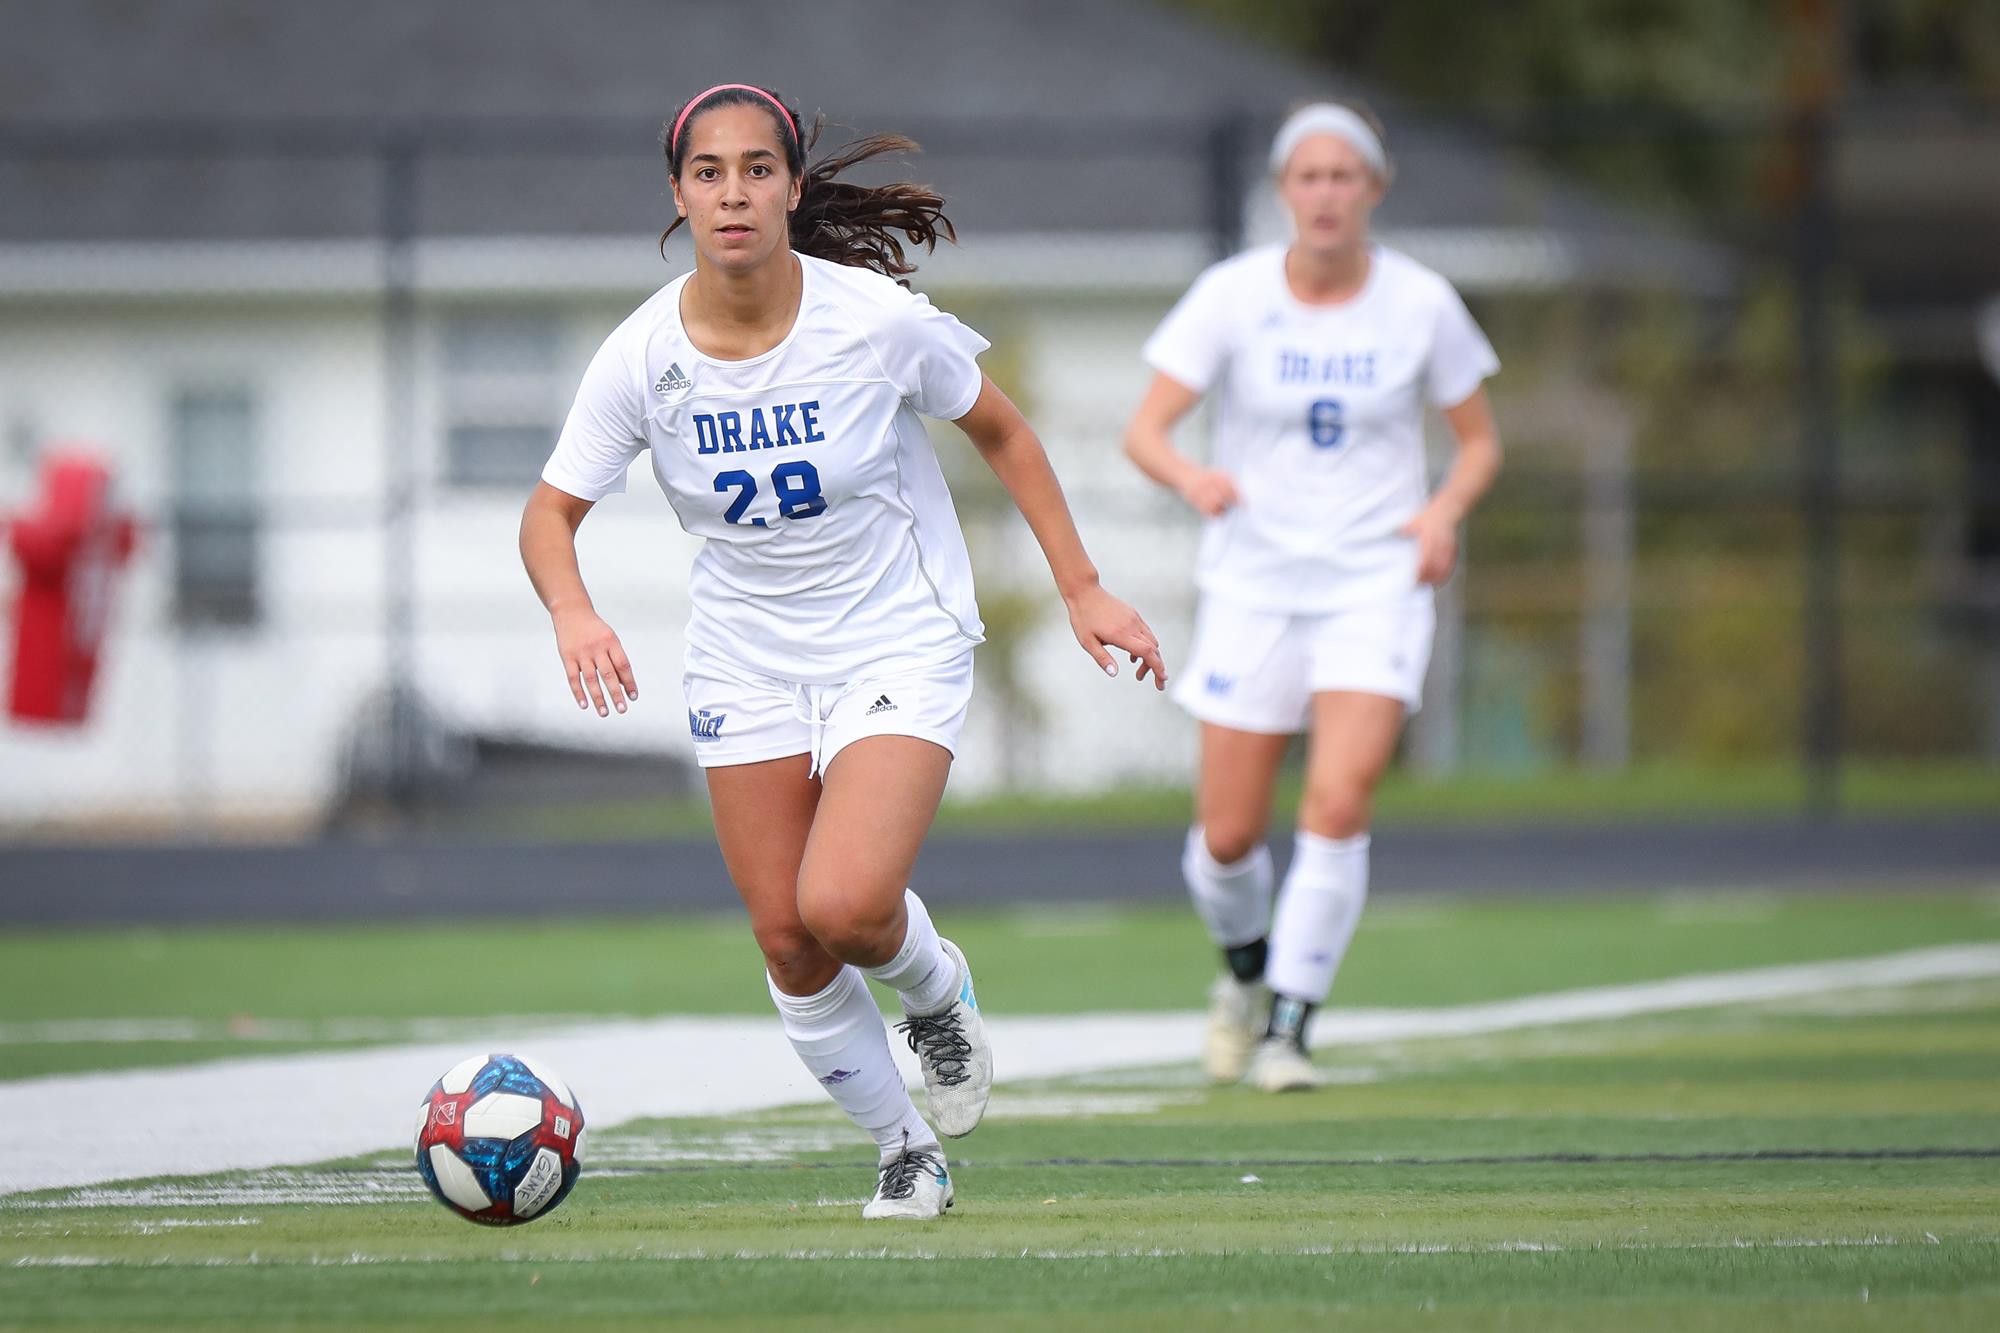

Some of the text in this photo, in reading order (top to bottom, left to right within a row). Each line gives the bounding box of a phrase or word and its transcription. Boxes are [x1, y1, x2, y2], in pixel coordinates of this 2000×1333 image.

[655, 379, 691, 392] adidas
[693, 401, 825, 454] DRAKE
[1307, 398, 1346, 451] 6
[713, 460, 828, 529] 28
[865, 704, 898, 716] adidas
[517, 1155, 551, 1200] GAME
